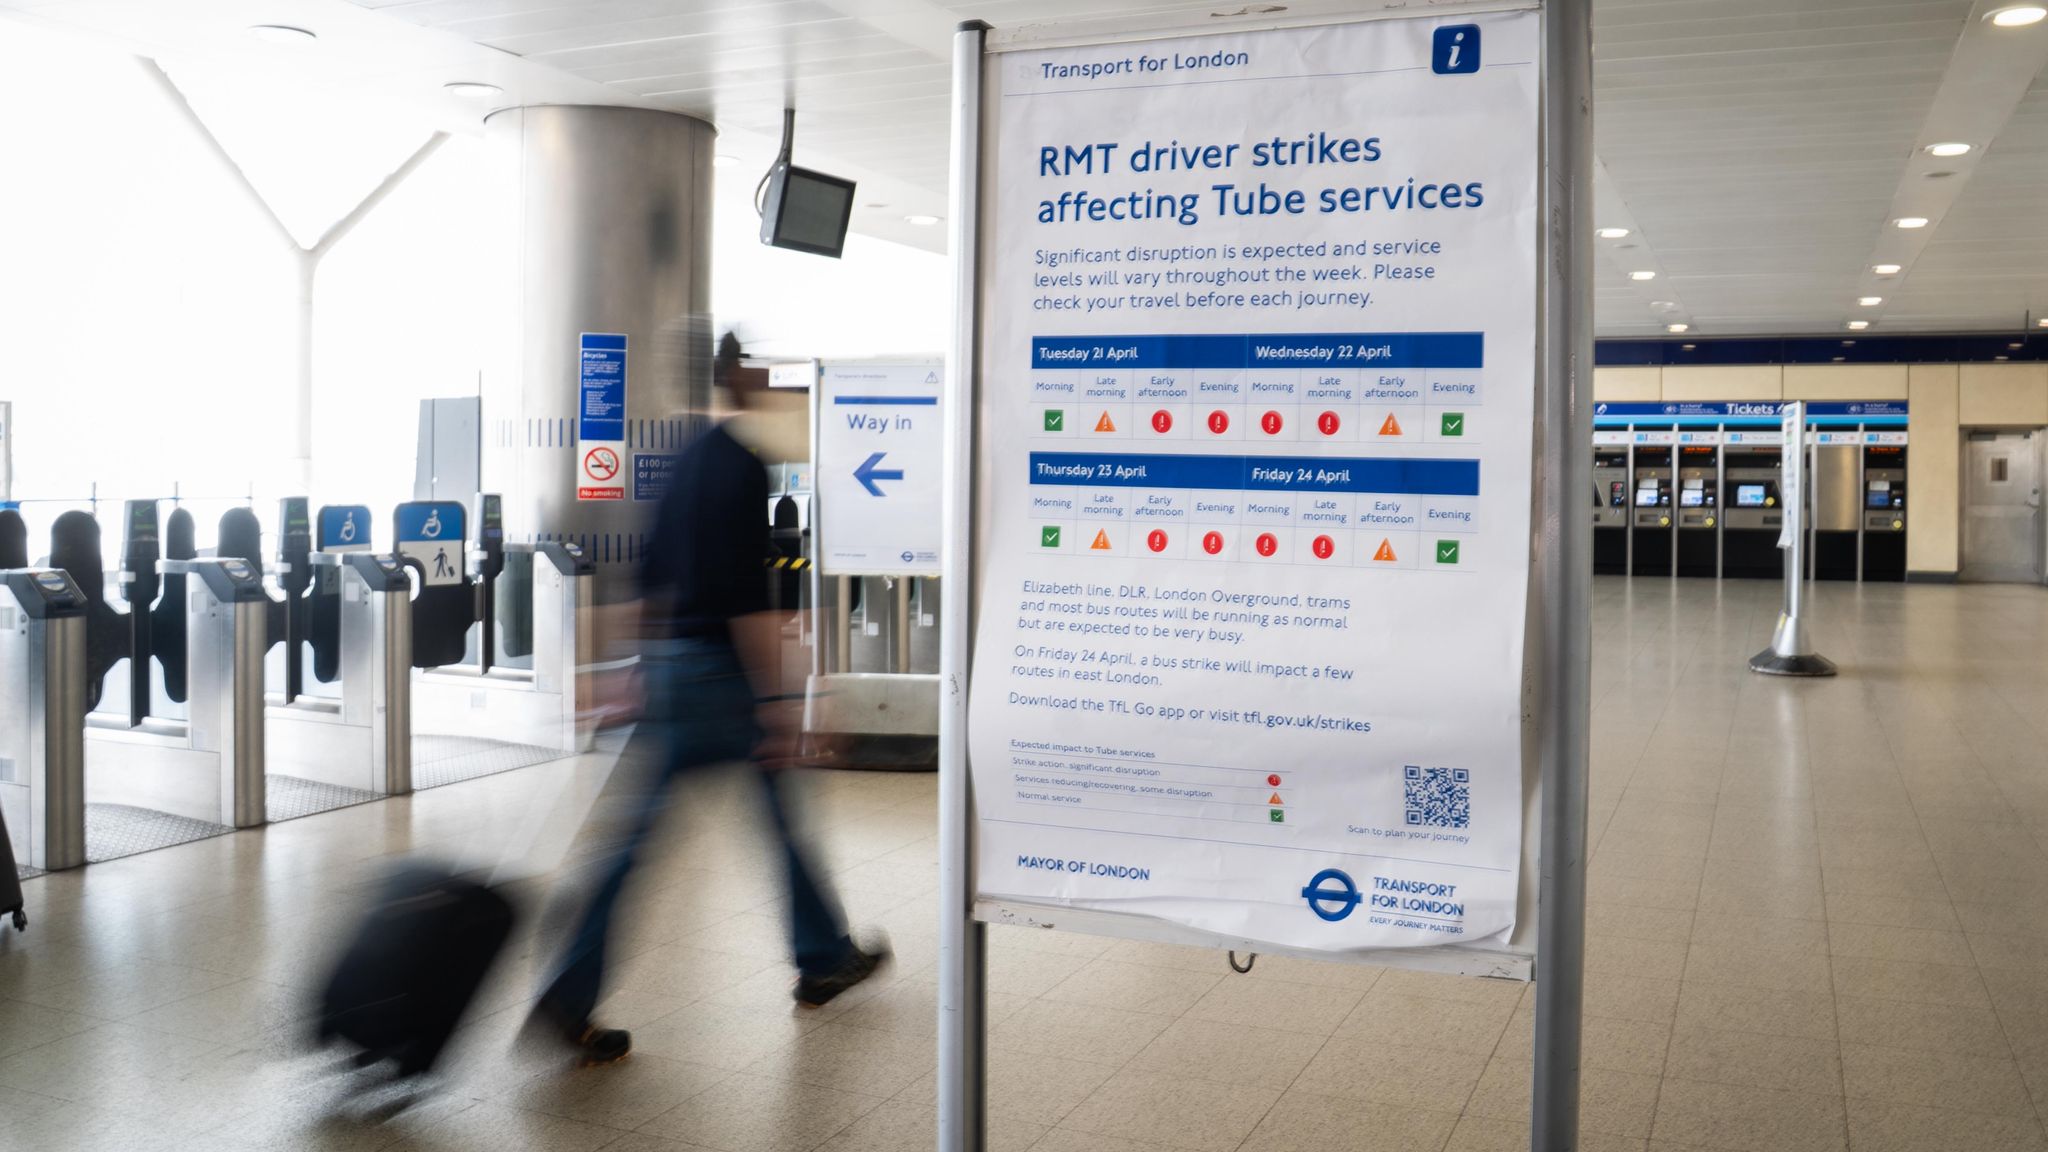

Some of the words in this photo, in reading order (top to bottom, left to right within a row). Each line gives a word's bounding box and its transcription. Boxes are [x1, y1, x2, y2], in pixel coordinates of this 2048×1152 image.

[1041, 58, 1133, 79] Transport
[1139, 55, 1168, 72] for
[1175, 50, 1248, 70] London
[1040, 143, 1118, 176] RMT
[1130, 140, 1240, 172] driver
[1253, 132, 1381, 167] strikes
[1038, 188, 1199, 226] affecting
[1212, 183, 1305, 216] Tube
[1320, 177, 1483, 213] services
[1035, 248, 1121, 268] Significant
[1126, 245, 1217, 264] disruption
[1223, 244, 1236, 259] is
[1242, 241, 1326, 261] expected
[1333, 240, 1366, 256] and
[1373, 239, 1441, 255] service
[1035, 272, 1083, 287] levels
[1088, 270, 1119, 286] will
[1124, 273, 1161, 288] vary
[1166, 267, 1270, 287] throughout
[1275, 266, 1306, 282] the
[1313, 265, 1366, 281] week.
[1374, 264, 1435, 279] Please
[1033, 295, 1081, 310] check
[1087, 297, 1125, 313] your
[1130, 292, 1180, 308] travel
[1186, 291, 1244, 307] before
[1250, 290, 1292, 306] each
[1297, 291, 1373, 309] journey.
[1040, 347, 1090, 362] Tuesday
[1093, 347, 1103, 359] 21
[1106, 347, 1138, 361] April
[1256, 346, 1334, 361] Wednesday
[1338, 345, 1353, 358] 22
[1356, 345, 1392, 360] April
[1036, 382, 1074, 393] Morning
[1097, 377, 1116, 385] Late
[1151, 376, 1175, 387] Early
[1200, 382, 1239, 393] Evening
[1319, 376, 1341, 386] Late
[1379, 376, 1405, 388] Early
[1086, 389, 1126, 399] morning
[1138, 388, 1187, 397] afternoon
[1252, 382, 1294, 394] Morning
[1307, 389, 1352, 400] morning
[1365, 388, 1418, 398] afternoon
[1433, 382, 1475, 394] Evening
[1726, 403, 1774, 416] Tickets
[847, 414, 888, 434] Way
[895, 414, 912, 430] in
[638, 471, 648, 479] or
[1037, 463, 1095, 479] Thursday
[1098, 464, 1112, 477] 23
[1114, 465, 1147, 479] April
[1252, 468, 1294, 484] Friday
[1297, 468, 1313, 481] 24
[1315, 469, 1350, 484] April
[581, 489, 592, 497] No
[592, 488, 622, 499] smoking
[1094, 494, 1114, 503] Late
[1034, 498, 1072, 509] Morning
[1148, 495, 1172, 507] Early
[1315, 500, 1337, 509] Late
[1375, 501, 1401, 514] Early
[1084, 506, 1123, 517] morning
[1135, 506, 1183, 516] afternoon
[1196, 502, 1235, 514] Evening
[1248, 504, 1290, 516] Morning
[1303, 513, 1347, 524] morning
[1360, 513, 1414, 524] afternoon
[1428, 509, 1471, 522] Evening
[1023, 580, 1083, 595] Elizabeth
[1154, 587, 1207, 601] London
[1307, 596, 1350, 610] trams
[1021, 600, 1045, 612] and
[1049, 603, 1083, 614] most
[1086, 602, 1110, 615] bus
[1115, 606, 1158, 618] routes
[1163, 607, 1188, 620] will
[1192, 608, 1209, 621] be
[1214, 612, 1269, 628] running
[1273, 615, 1289, 626] as
[1294, 616, 1348, 629] normal
[1018, 616, 1041, 629] but
[1044, 621, 1065, 631] are
[1069, 622, 1130, 635] expected
[1134, 625, 1149, 636] to
[1153, 625, 1170, 637] be
[1174, 628, 1205, 642] very
[1209, 628, 1244, 645] busy.
[1014, 645, 1034, 657] On
[1038, 646, 1078, 664] Friday
[1081, 649, 1095, 662] 24
[1141, 656, 1148, 666] a
[1153, 655, 1177, 668] bus
[1181, 658, 1221, 671] strike
[1225, 660, 1252, 673] will
[1256, 661, 1309, 679] impact
[1312, 668, 1320, 678] a
[1324, 666, 1354, 679] few
[1012, 666, 1054, 678] routes
[1058, 667, 1070, 678] in
[1074, 670, 1103, 681] east
[1106, 670, 1162, 686] London.
[1009, 692, 1077, 710] Download
[1081, 698, 1104, 712] the
[1108, 700, 1130, 714] TfL
[1134, 702, 1154, 716] Go
[1159, 707, 1185, 720] app
[1189, 709, 1205, 719] or
[1209, 709, 1239, 722] visit
[1243, 711, 1371, 732] tfl.gov.uk/strikes
[1011, 739, 1050, 751] Expected
[1052, 743, 1082, 755] impact
[1096, 746, 1117, 755] Tube
[1120, 750, 1155, 758] services
[1013, 757, 1036, 766] Strike
[1069, 763, 1114, 772] significant
[1115, 766, 1160, 776] disruption
[1015, 774, 1050, 784] Services
[1166, 788, 1213, 798] disruption
[1018, 791, 1050, 800] Normal
[1051, 795, 1081, 803] service
[1348, 825, 1370, 834] Scan
[1372, 828, 1383, 836] to
[1384, 827, 1407, 839] plan
[1408, 830, 1431, 841] your
[1432, 831, 1470, 845] journey
[1018, 855, 1064, 871] MAYOR
[1067, 861, 1086, 873] OF
[1090, 863, 1150, 880] LONDON
[1374, 877, 1456, 897] TRANSPORT
[1372, 894, 1398, 908] FOR
[1403, 898, 1464, 916] LONDON
[1369, 916, 1392, 924] EVERY
[1393, 920, 1427, 929] JOURNEY
[1430, 924, 1463, 935] MATTERS
